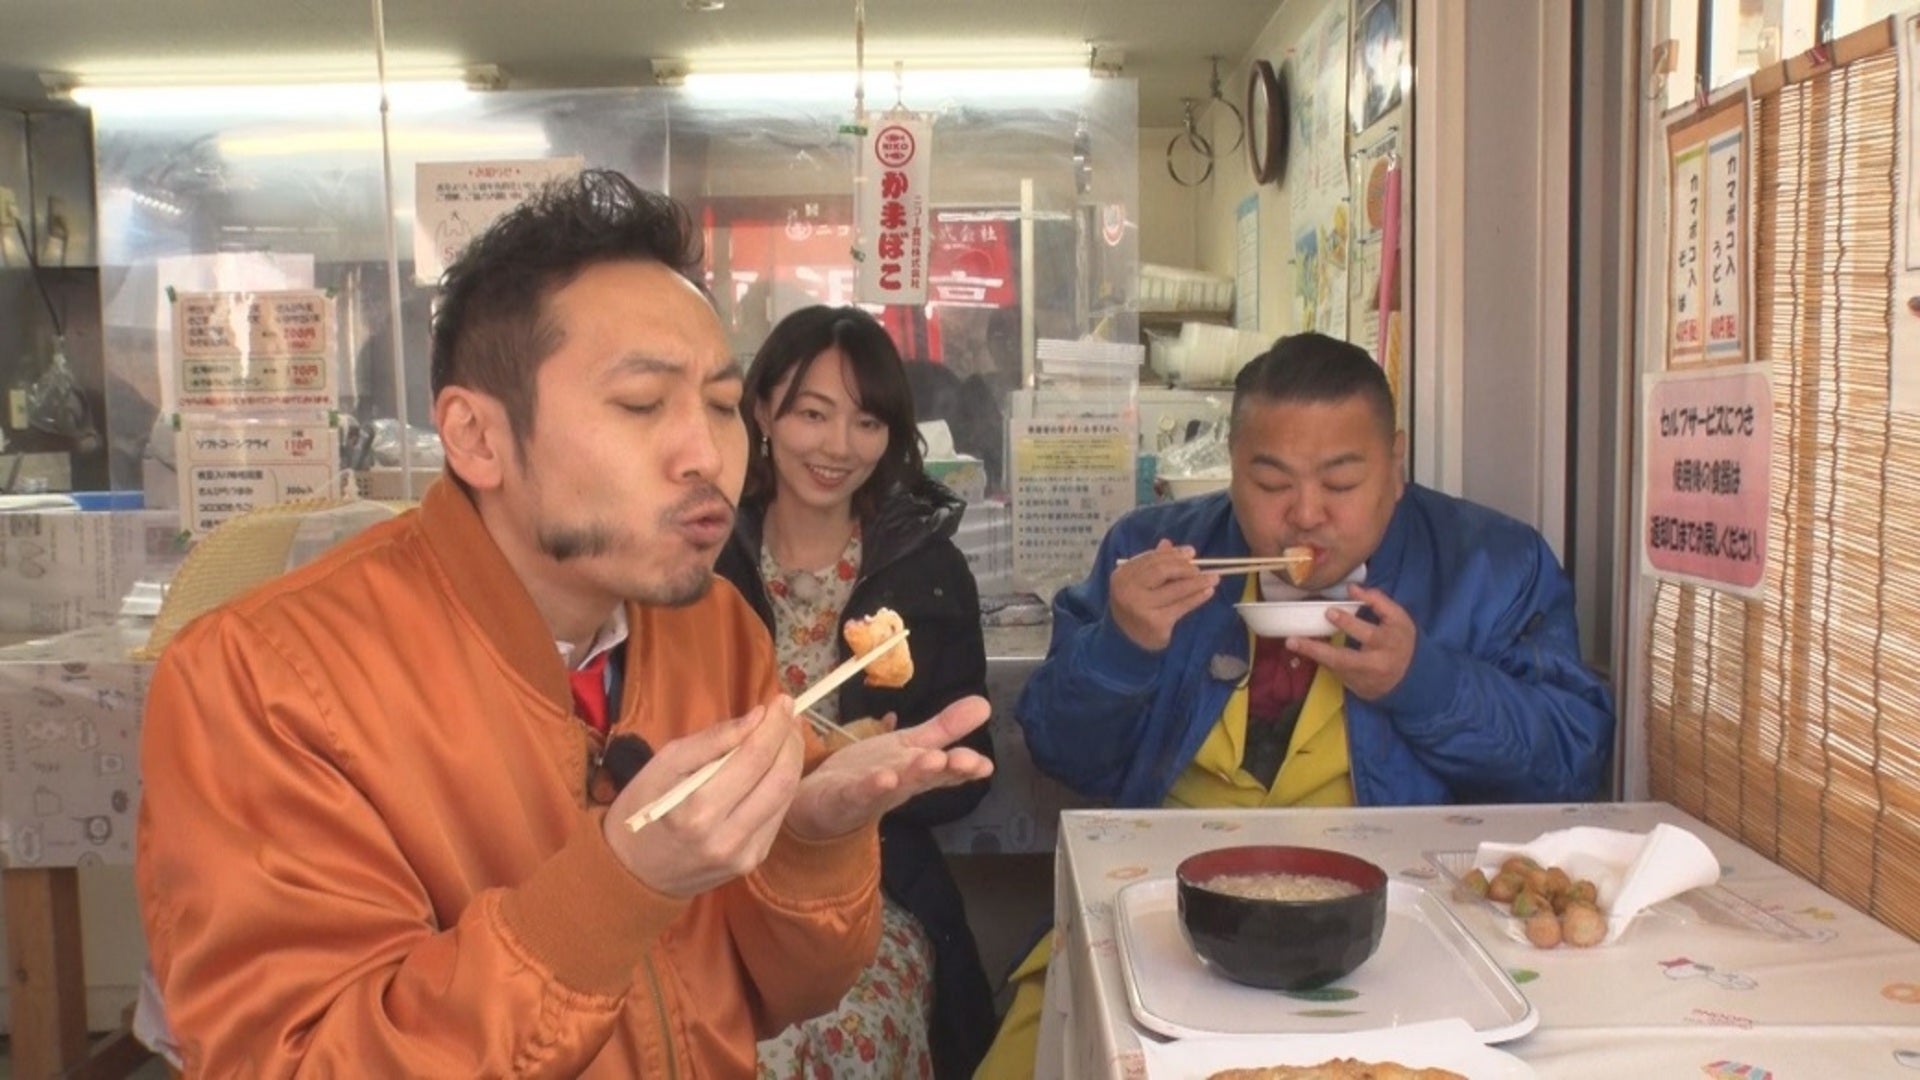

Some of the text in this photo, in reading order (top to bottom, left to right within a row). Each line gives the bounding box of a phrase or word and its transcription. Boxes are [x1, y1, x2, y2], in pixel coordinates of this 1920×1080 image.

[878, 171, 909, 291] かまぼこ
[1725, 155, 1736, 276] カマボコ入
[1712, 242, 1723, 307] うどん
[1660, 404, 1755, 438] セルフサービスにつき
[1673, 459, 1742, 495] 使用後の食器は
